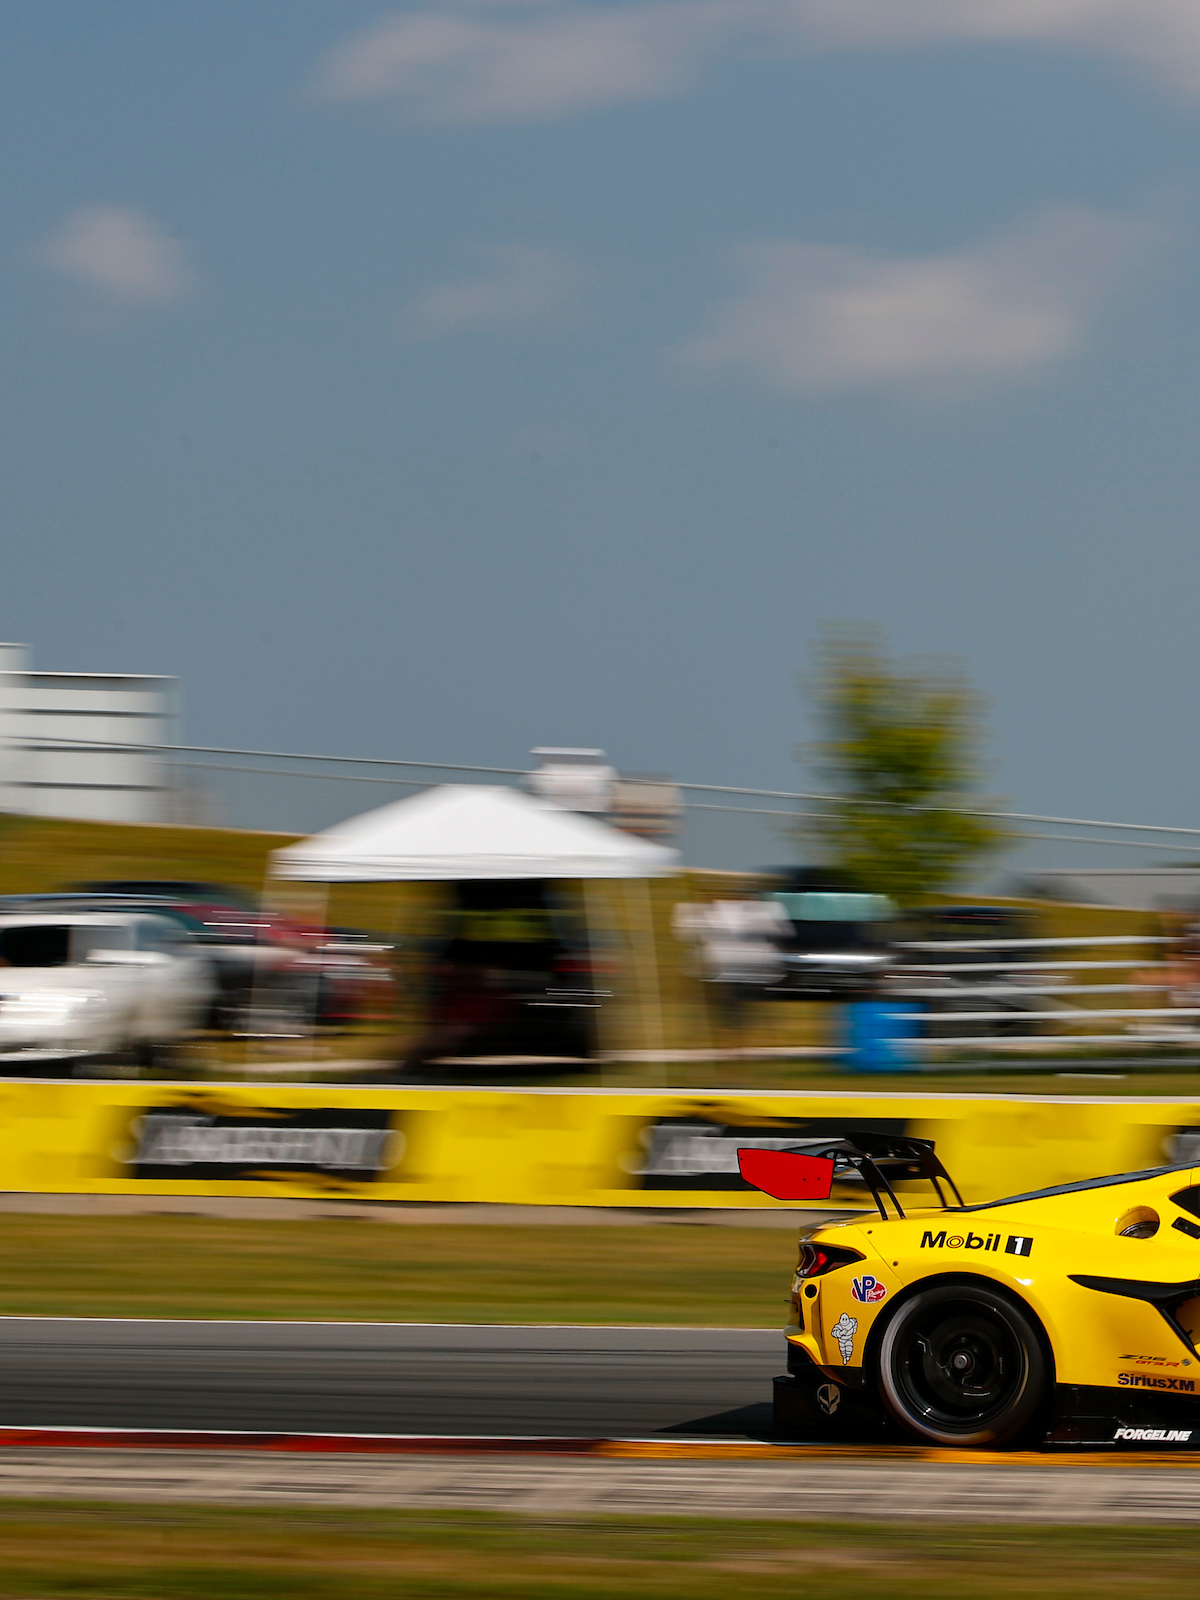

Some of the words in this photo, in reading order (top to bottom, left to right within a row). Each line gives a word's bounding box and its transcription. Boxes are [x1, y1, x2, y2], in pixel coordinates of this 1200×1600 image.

[920, 1231, 1001, 1251] Mobil
[852, 1276, 876, 1302] VP
[1117, 1373, 1195, 1392] SiriusXM
[1113, 1428, 1193, 1441] FORGELINE
